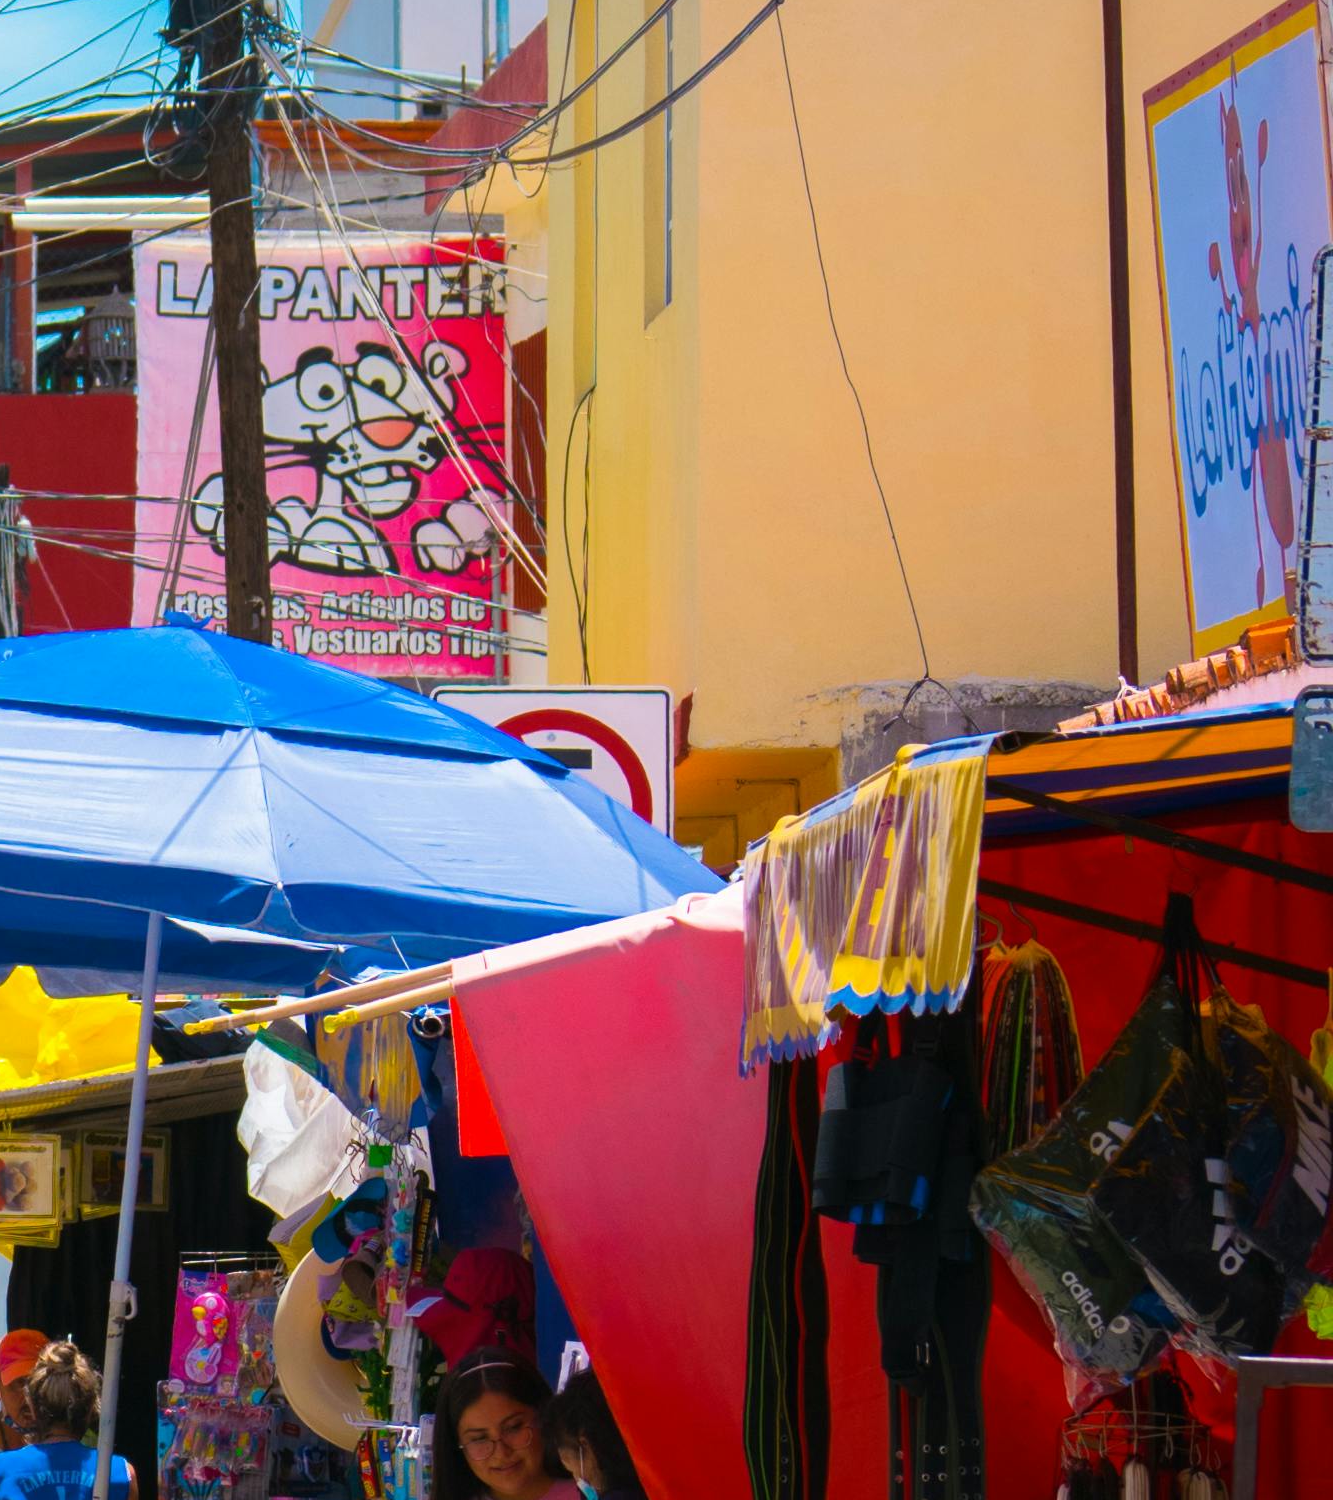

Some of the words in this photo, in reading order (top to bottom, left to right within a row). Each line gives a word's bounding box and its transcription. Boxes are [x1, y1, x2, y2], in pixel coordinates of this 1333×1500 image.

[320, 589, 446, 622] Artículos
[451, 590, 487, 623] de
[293, 623, 442, 657] Vestuarios
[1290, 1075, 1332, 1218] NIKE
[1061, 1271, 1106, 1340] adidas
